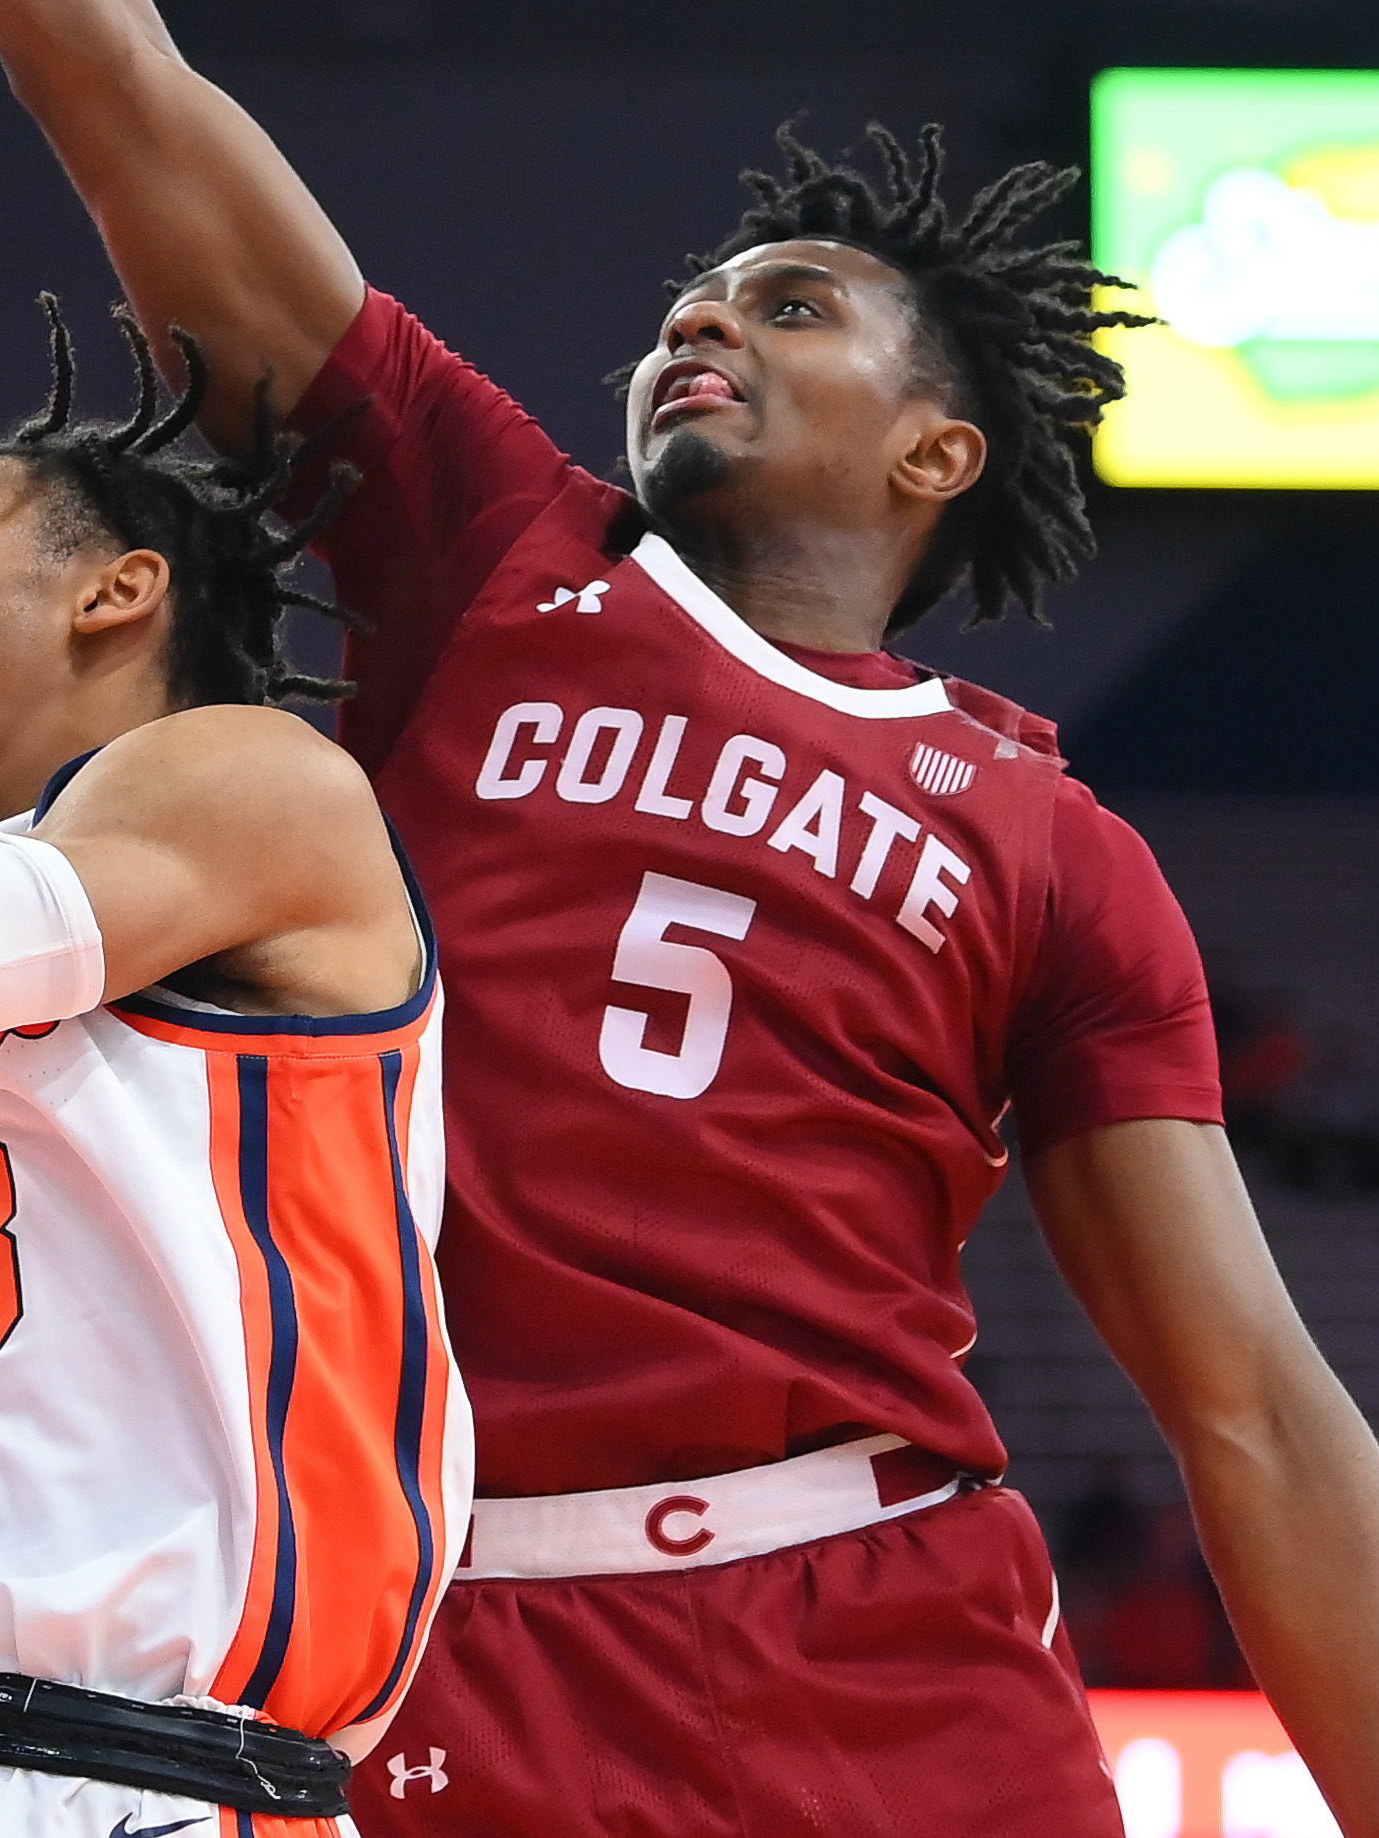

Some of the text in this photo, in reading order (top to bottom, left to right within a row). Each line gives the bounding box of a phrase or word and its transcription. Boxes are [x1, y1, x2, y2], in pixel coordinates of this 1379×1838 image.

[475, 701, 972, 955] COLGATE
[598, 870, 757, 1100] 5
[645, 1495, 716, 1557] C
